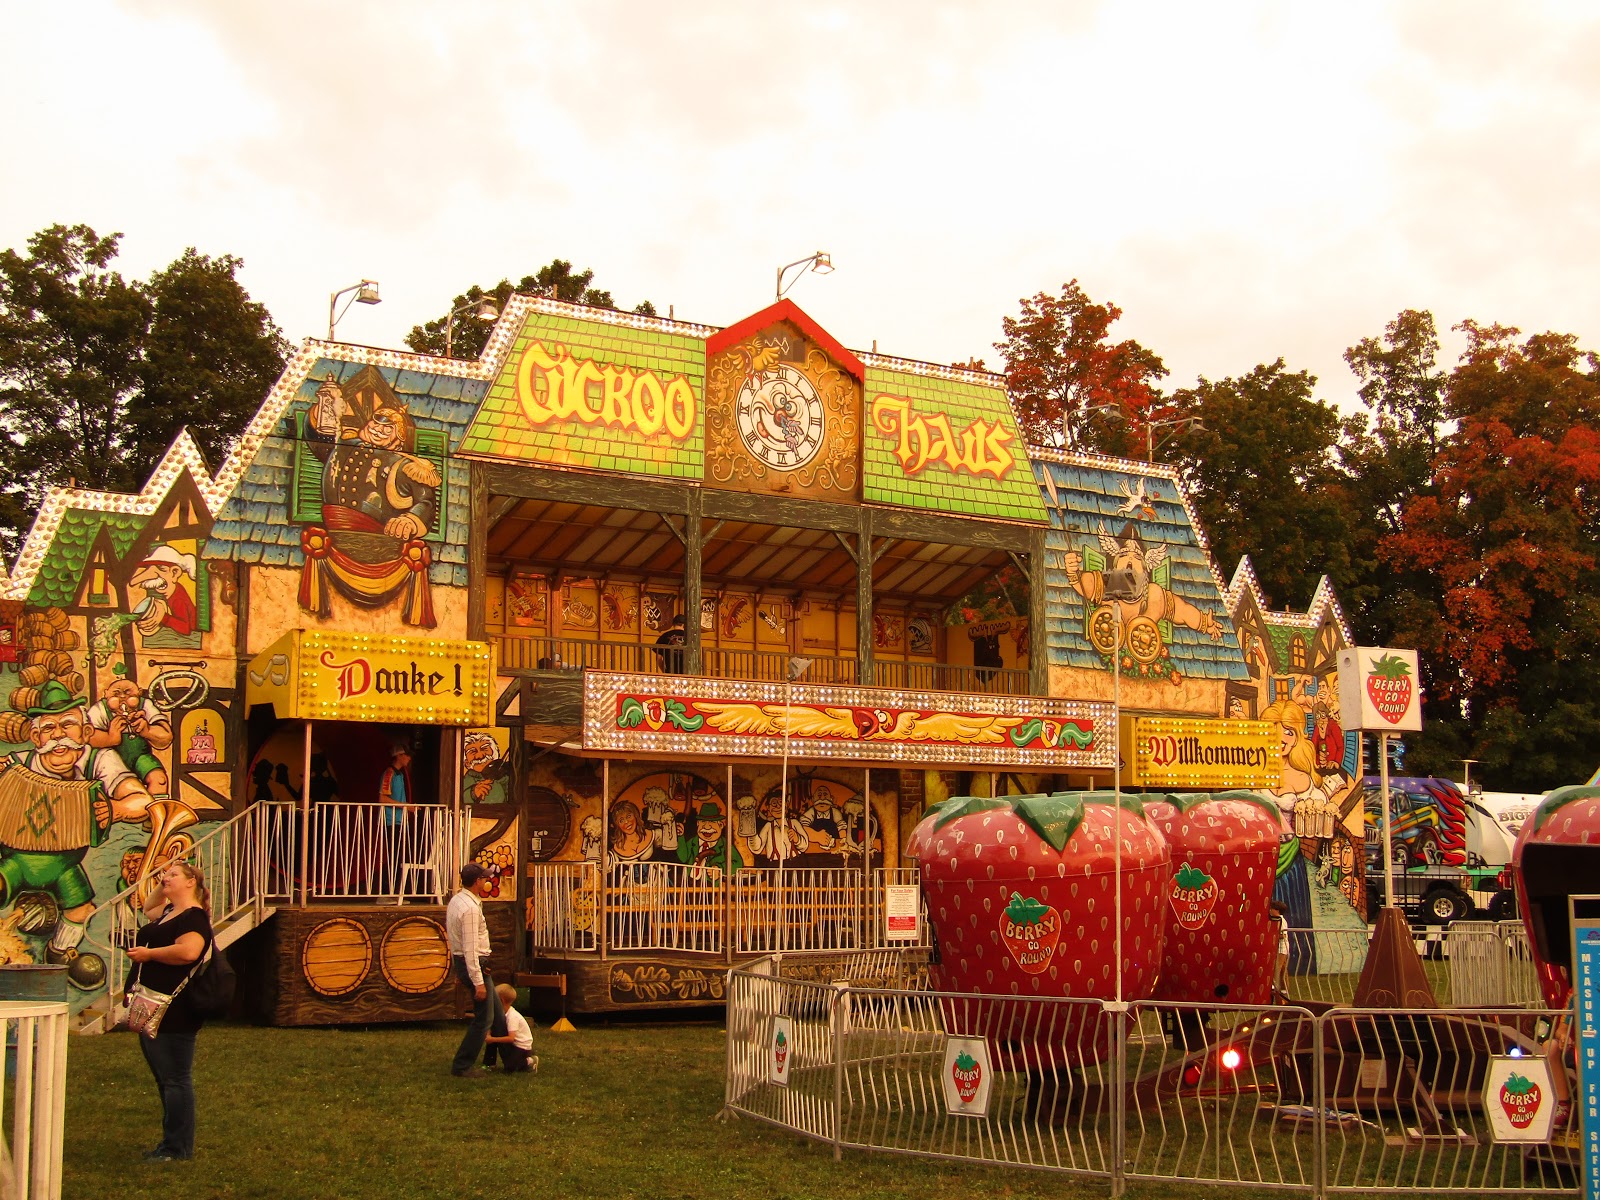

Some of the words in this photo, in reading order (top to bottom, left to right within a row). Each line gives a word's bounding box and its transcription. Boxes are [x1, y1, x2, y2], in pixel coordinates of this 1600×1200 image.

[1373, 679, 1407, 691] BERRY
[1384, 692, 1398, 702] GO
[1378, 702, 1406, 713] ROUND
[1147, 734, 1267, 771] Willkommen
[1172, 885, 1213, 902] BERRY
[1181, 909, 1207, 921] ROUND
[1005, 916, 1055, 940] BERRY
[1028, 941, 1039, 950] GO
[1020, 946, 1051, 964] ROUND
[1581, 953, 1593, 1032] MEASURE
[1586, 1048, 1595, 1069] UP
[954, 1068, 979, 1081] BERRY
[1503, 1090, 1538, 1106] BERRY
[1589, 1083, 1598, 1117] FOR
[1511, 1111, 1534, 1122] ROUND
[1590, 1131, 1600, 1200] SAFETY
